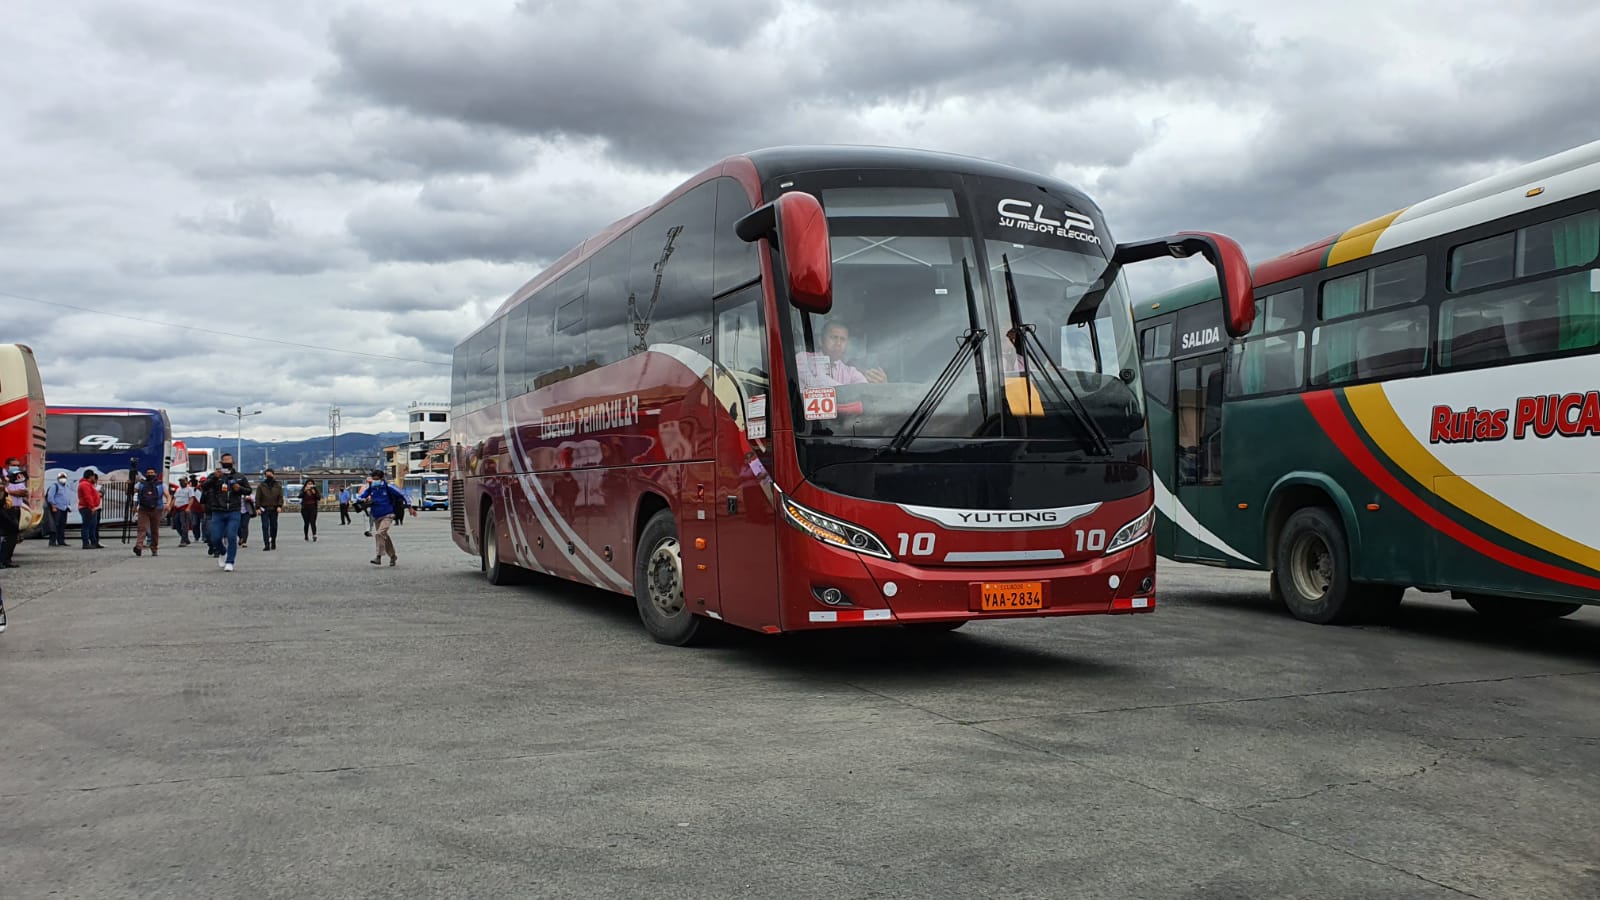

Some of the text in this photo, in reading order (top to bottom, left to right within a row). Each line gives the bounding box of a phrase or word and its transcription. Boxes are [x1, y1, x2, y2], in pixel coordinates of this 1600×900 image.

[999, 217, 1101, 245] SU MEJOR ELECCION
[1182, 327, 1220, 349] SALIDA
[807, 399, 834, 413] 40
[1430, 405, 1509, 444] Rutas
[958, 512, 1057, 523] YUTONG
[898, 532, 936, 556] 10
[1075, 529, 1106, 552] 10
[984, 592, 1040, 607] YAA-2834
